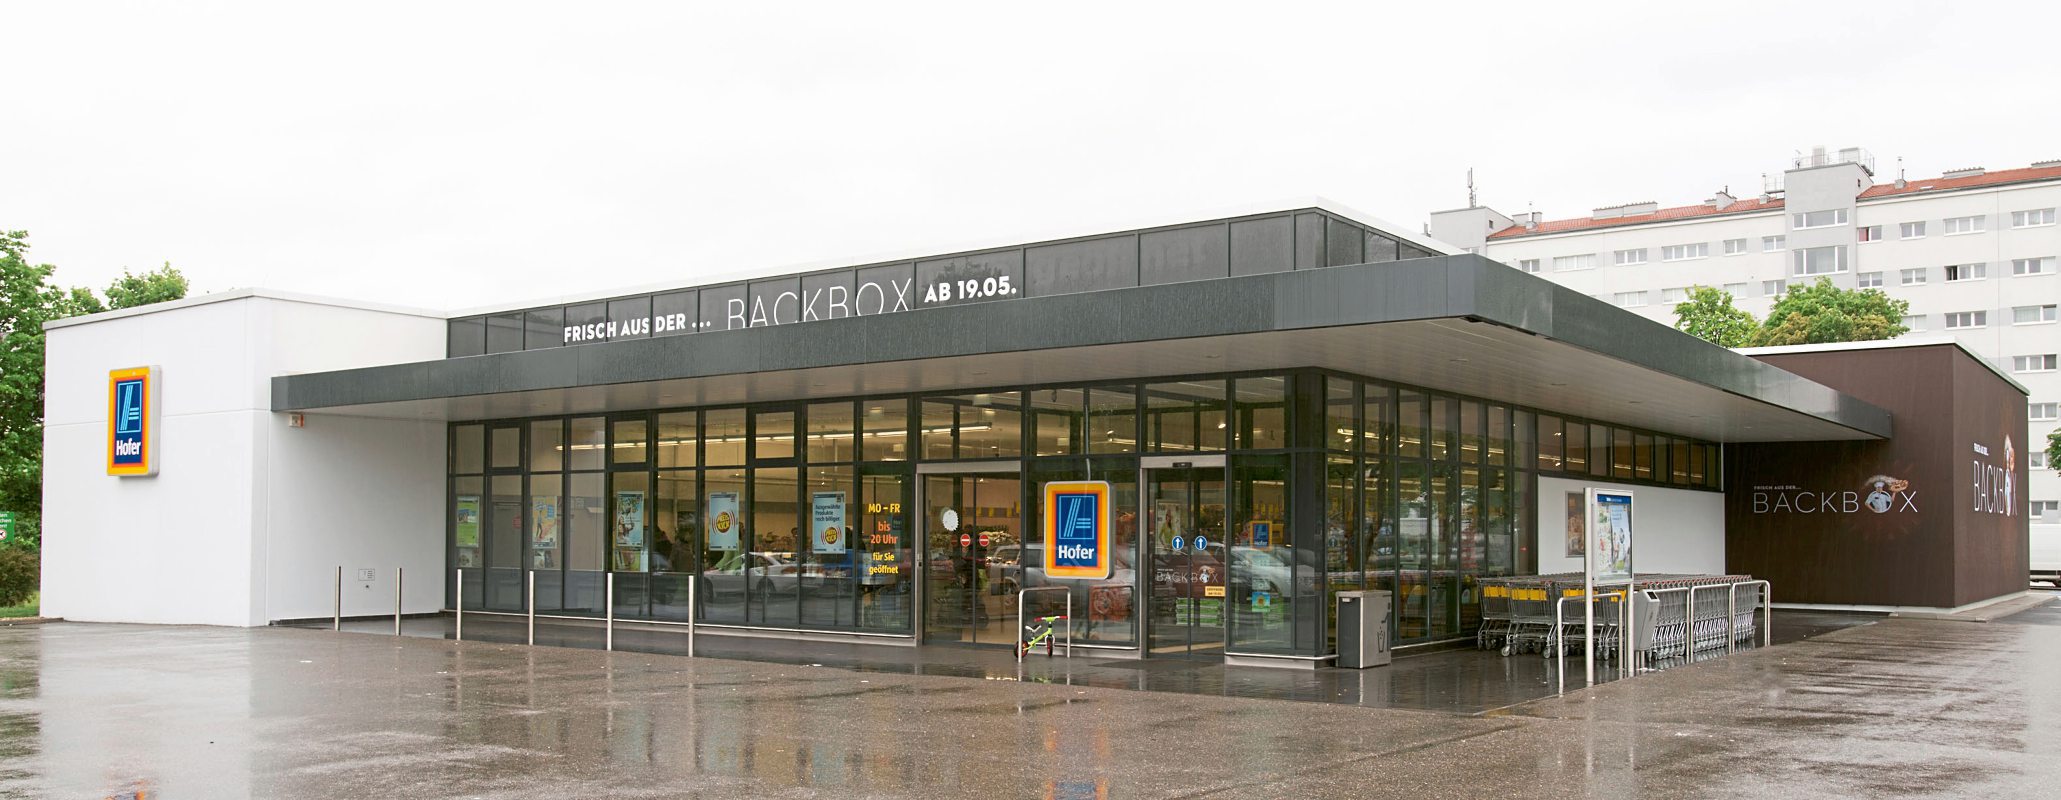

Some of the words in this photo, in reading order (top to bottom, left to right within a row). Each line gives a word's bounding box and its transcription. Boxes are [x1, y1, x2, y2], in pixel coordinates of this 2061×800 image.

[924, 282, 951, 303] AB
[957, 276, 1017, 300] 19.05.
[727, 278, 912, 330] BACKBOX
[564, 321, 617, 342] FRISCH
[620, 318, 650, 336] AUS
[655, 313, 686, 333] DER
[116, 438, 142, 455] Hofer
[868, 503, 881, 513] MO
[890, 503, 901, 513] FR
[1753, 491, 1918, 513] BACKBOX
[878, 520, 891, 532] bis
[870, 534, 881, 544] 20
[883, 533, 898, 544] Uhr
[873, 552, 883, 561] für
[884, 552, 895, 561] Sie
[1058, 544, 1095, 560] Hofer
[869, 564, 899, 575] geöffnet
